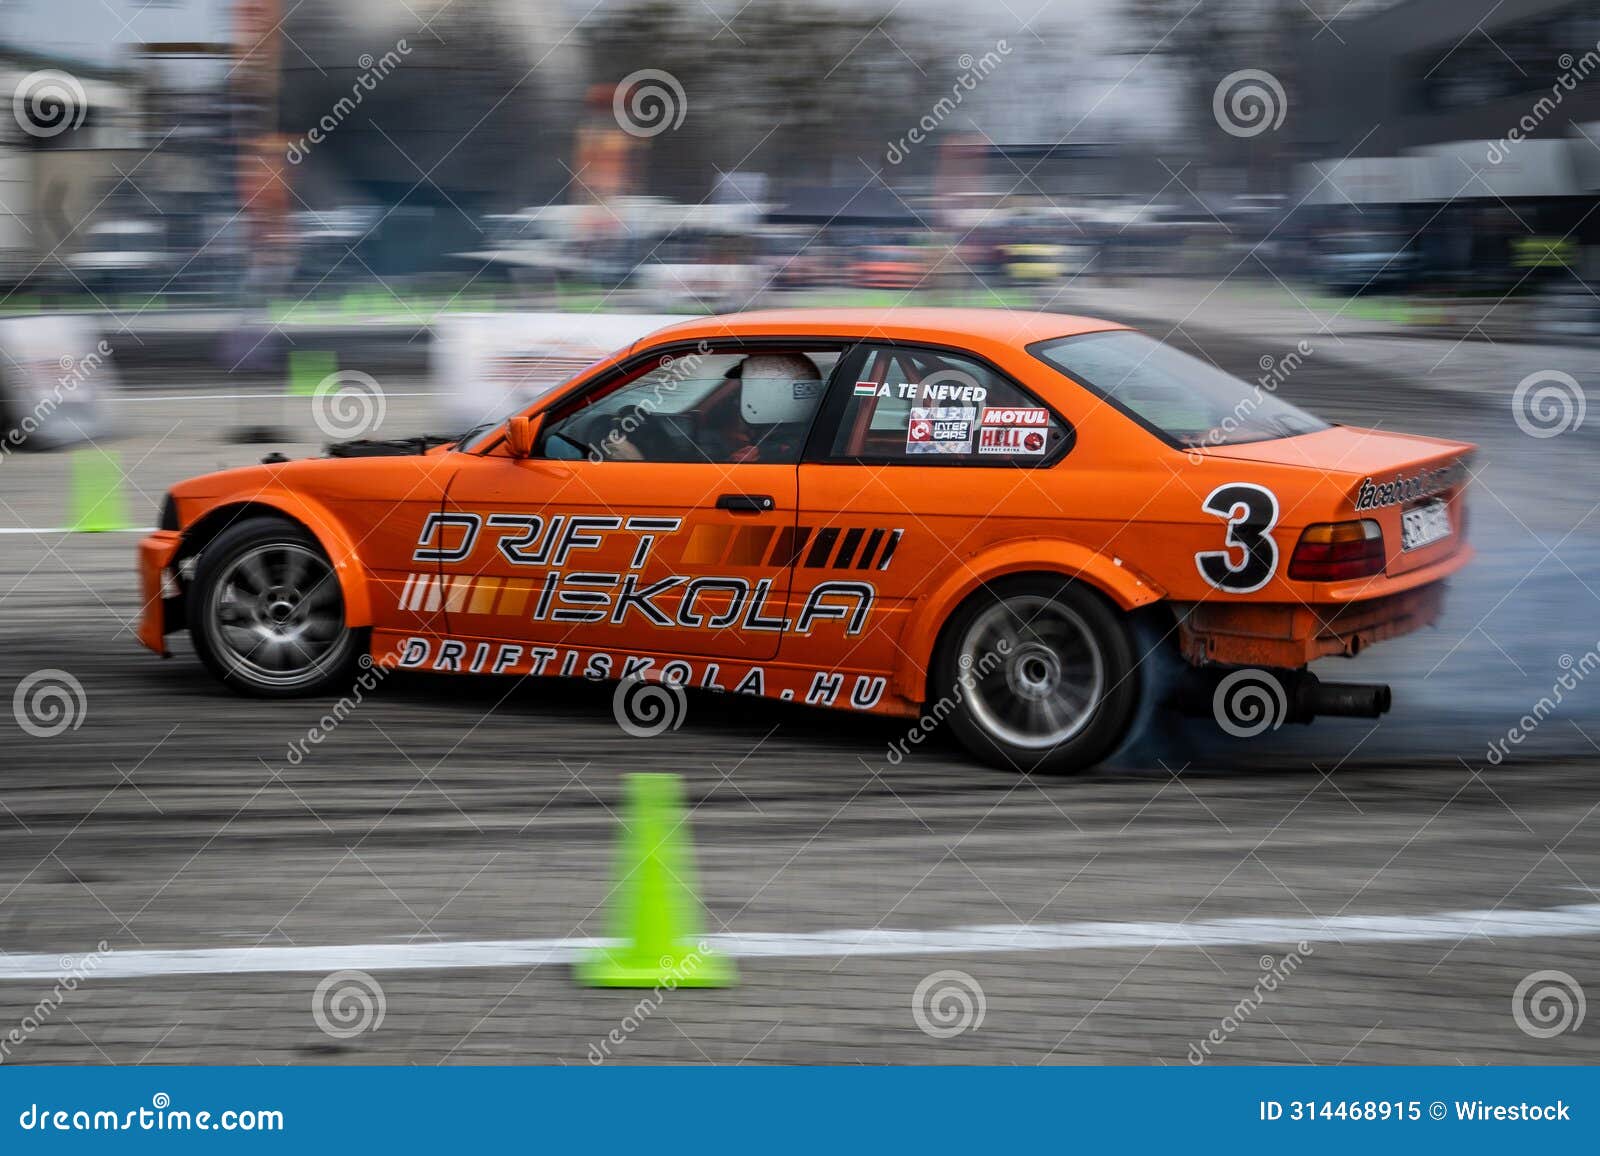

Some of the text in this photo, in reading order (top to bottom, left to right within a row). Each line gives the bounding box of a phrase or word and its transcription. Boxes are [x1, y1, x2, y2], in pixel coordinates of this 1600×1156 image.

[877, 383, 987, 402] A TE NEVED
[984, 410, 1046, 424] MOTUL
[933, 431, 967, 440] CARS
[934, 422, 968, 431] INTER
[981, 430, 1021, 447] HELL
[412, 512, 683, 569] DRIFT
[1194, 481, 1280, 595] 3
[533, 571, 876, 637] ISKOLA
